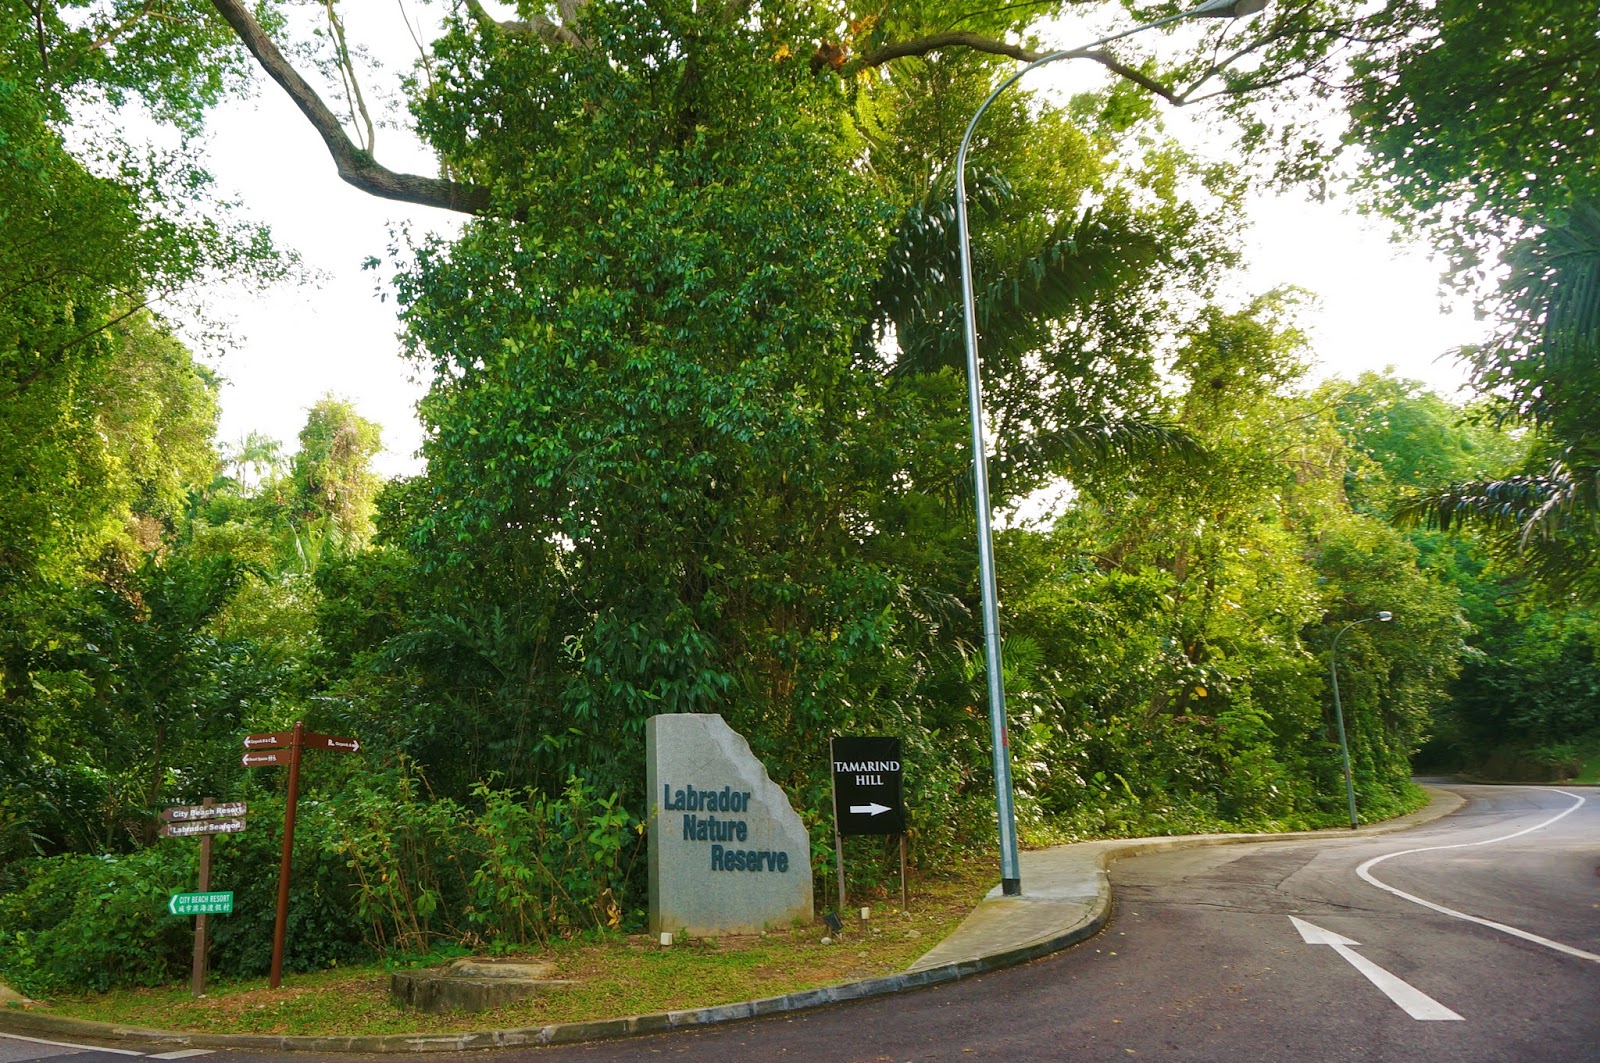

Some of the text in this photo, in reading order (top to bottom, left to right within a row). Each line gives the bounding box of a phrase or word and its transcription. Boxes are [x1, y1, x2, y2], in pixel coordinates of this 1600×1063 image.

[833, 760, 900, 772] TAMARIND
[855, 774, 884, 786] HILL
[664, 783, 751, 812] Labrador
[172, 806, 243, 819] City Beach Resort
[172, 822, 241, 834] Labrador Seafood
[683, 814, 747, 842] Nature
[711, 844, 789, 872] Reserve
[179, 894, 231, 904] CITY BEACH RESORT
